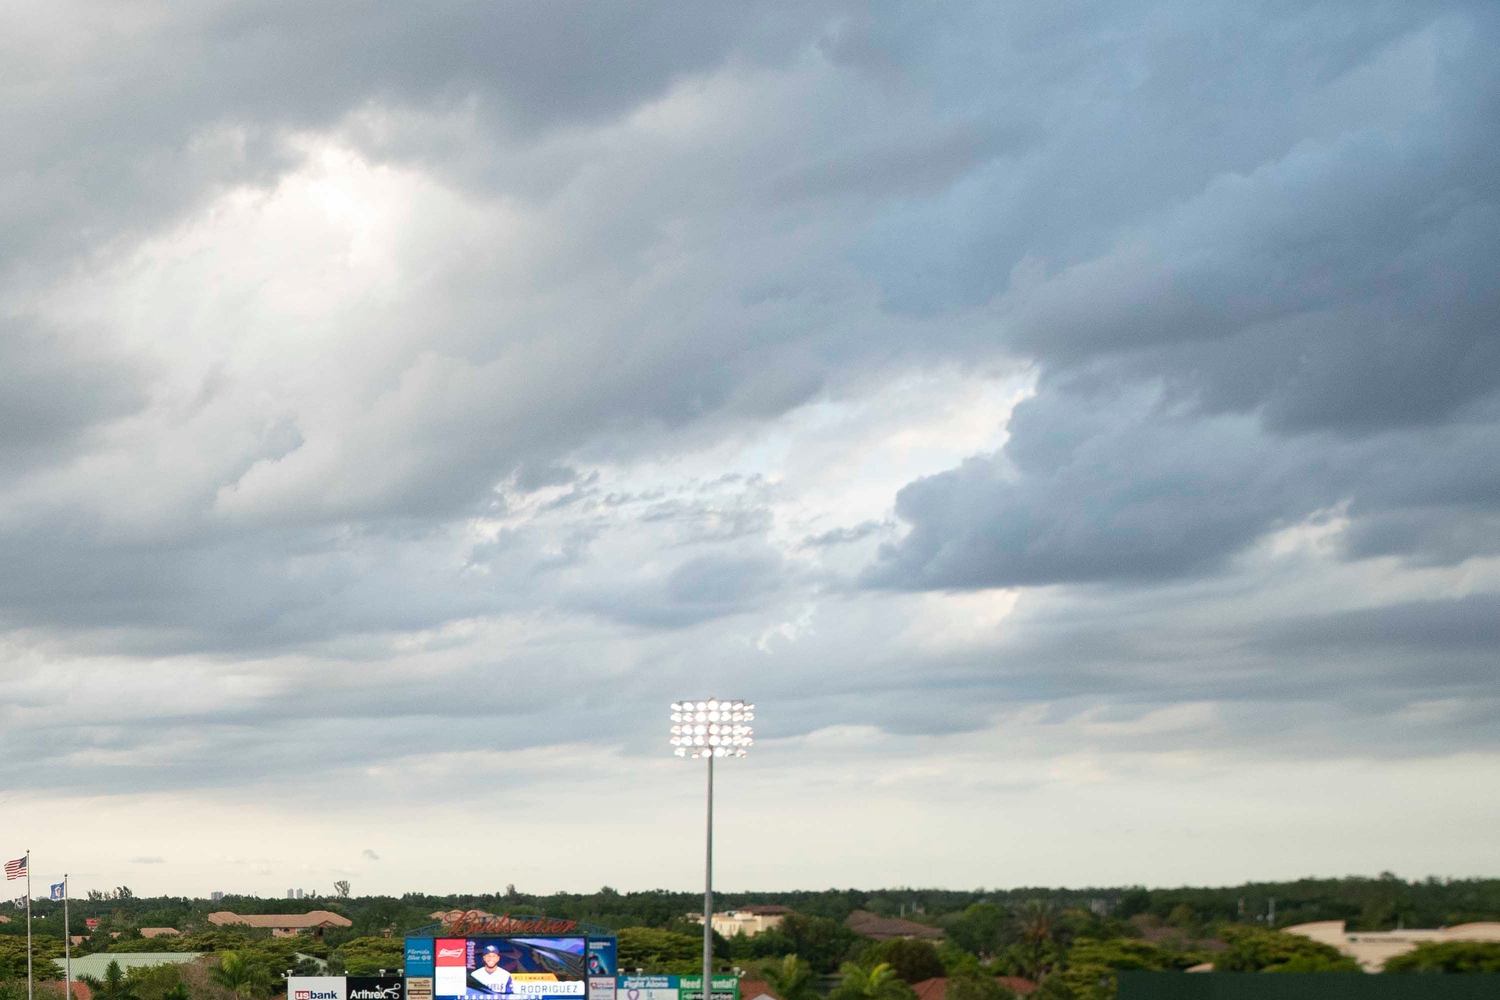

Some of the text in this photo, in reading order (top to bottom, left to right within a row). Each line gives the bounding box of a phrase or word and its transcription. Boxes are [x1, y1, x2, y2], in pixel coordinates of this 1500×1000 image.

[444, 911, 579, 936] Budweiser
[624, 981, 644, 989] Fight
[680, 979, 700, 988] Need
[521, 985, 578, 993] RODRIGUEZ
[350, 990, 386, 999] Arthrex
[682, 992, 733, 1000] enteprise
